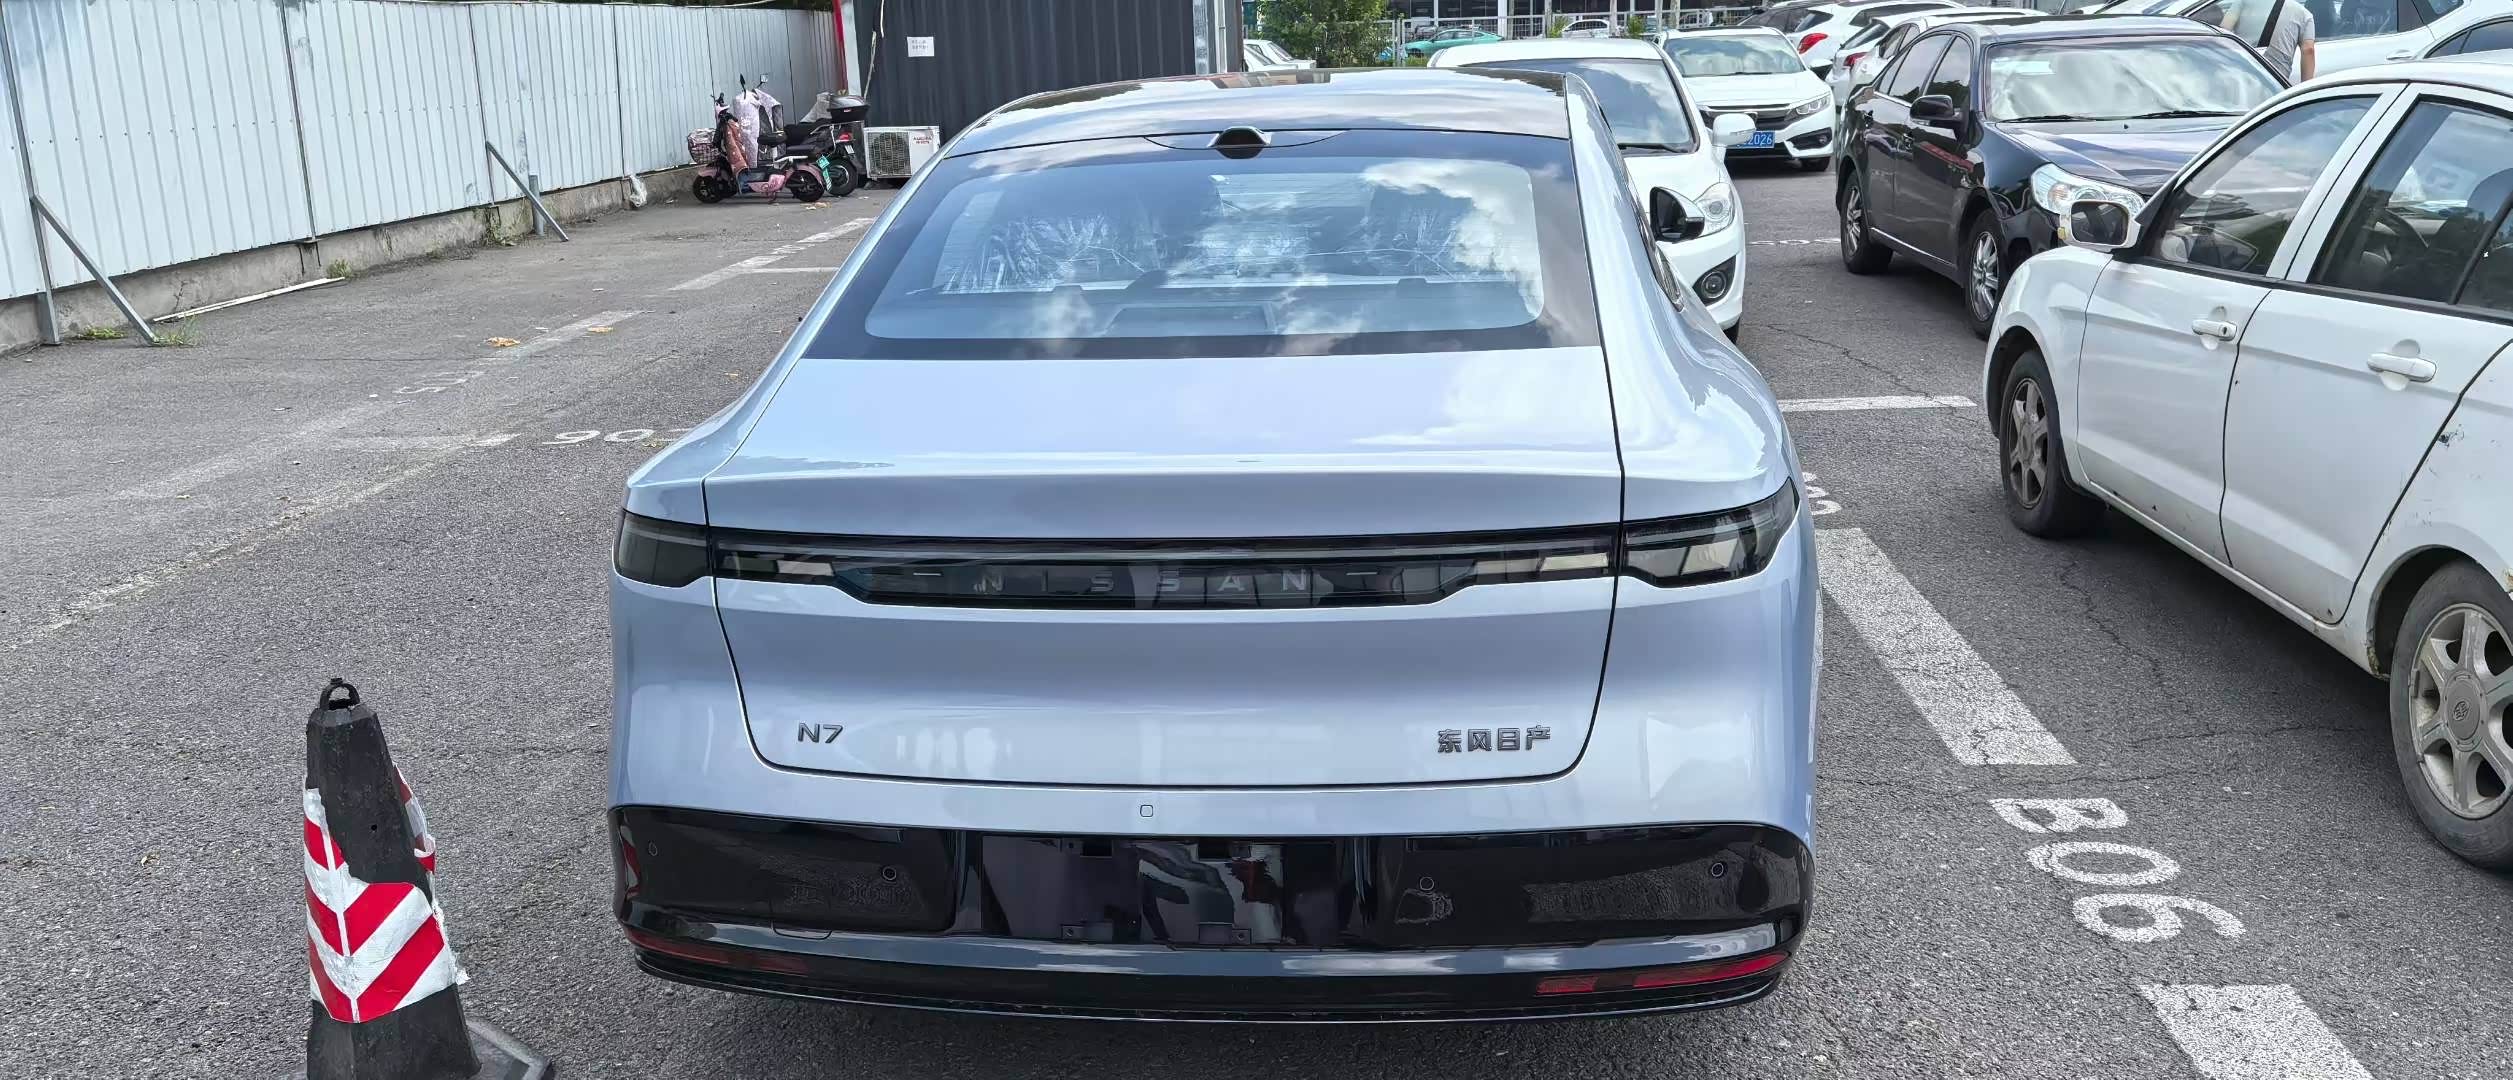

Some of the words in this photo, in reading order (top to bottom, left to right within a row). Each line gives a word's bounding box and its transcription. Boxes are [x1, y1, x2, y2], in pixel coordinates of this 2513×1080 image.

[1744, 134, 1773, 145] 2026
[981, 568, 1307, 592] NISSAN
[797, 722, 844, 744] N7
[1437, 724, 1551, 753] 东风日产
[1988, 797, 2246, 943] B06
